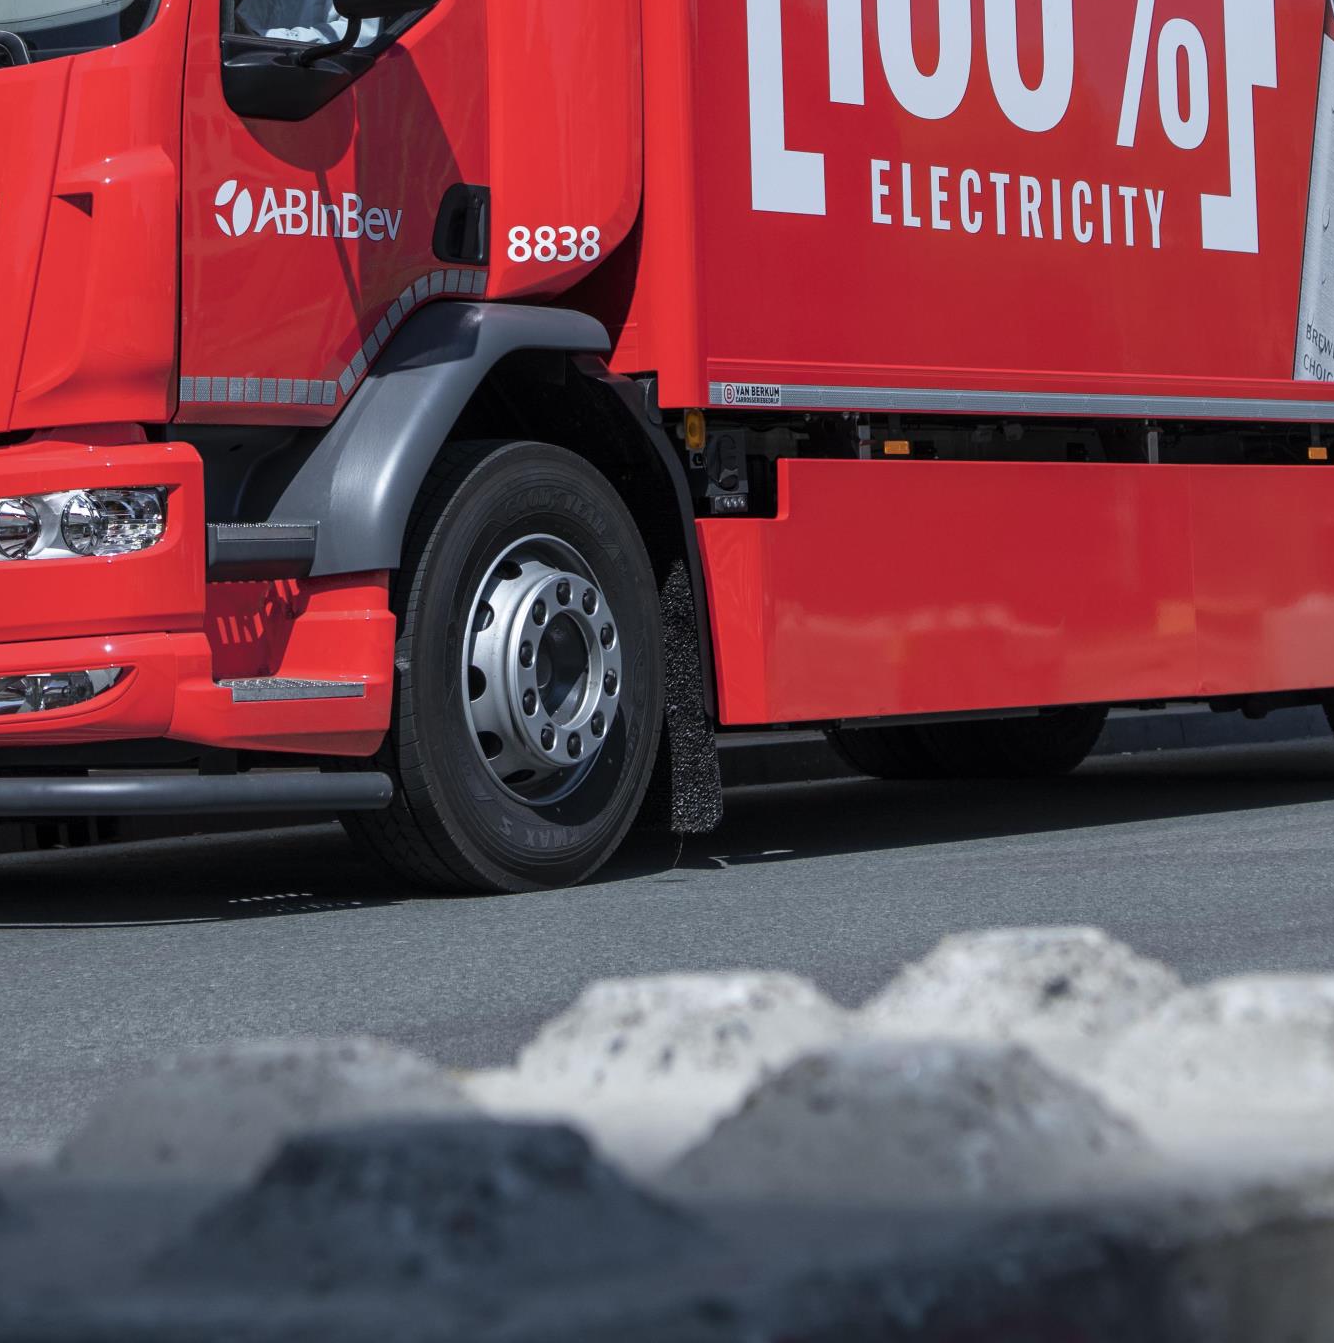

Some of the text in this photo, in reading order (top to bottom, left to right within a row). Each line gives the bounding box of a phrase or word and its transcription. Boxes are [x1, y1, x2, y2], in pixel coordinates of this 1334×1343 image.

[869, 157, 1166, 250] ELECTRICITY
[507, 225, 601, 263] 8838
[735, 386, 750, 396] VAN
[751, 386, 780, 397] BERKUM
